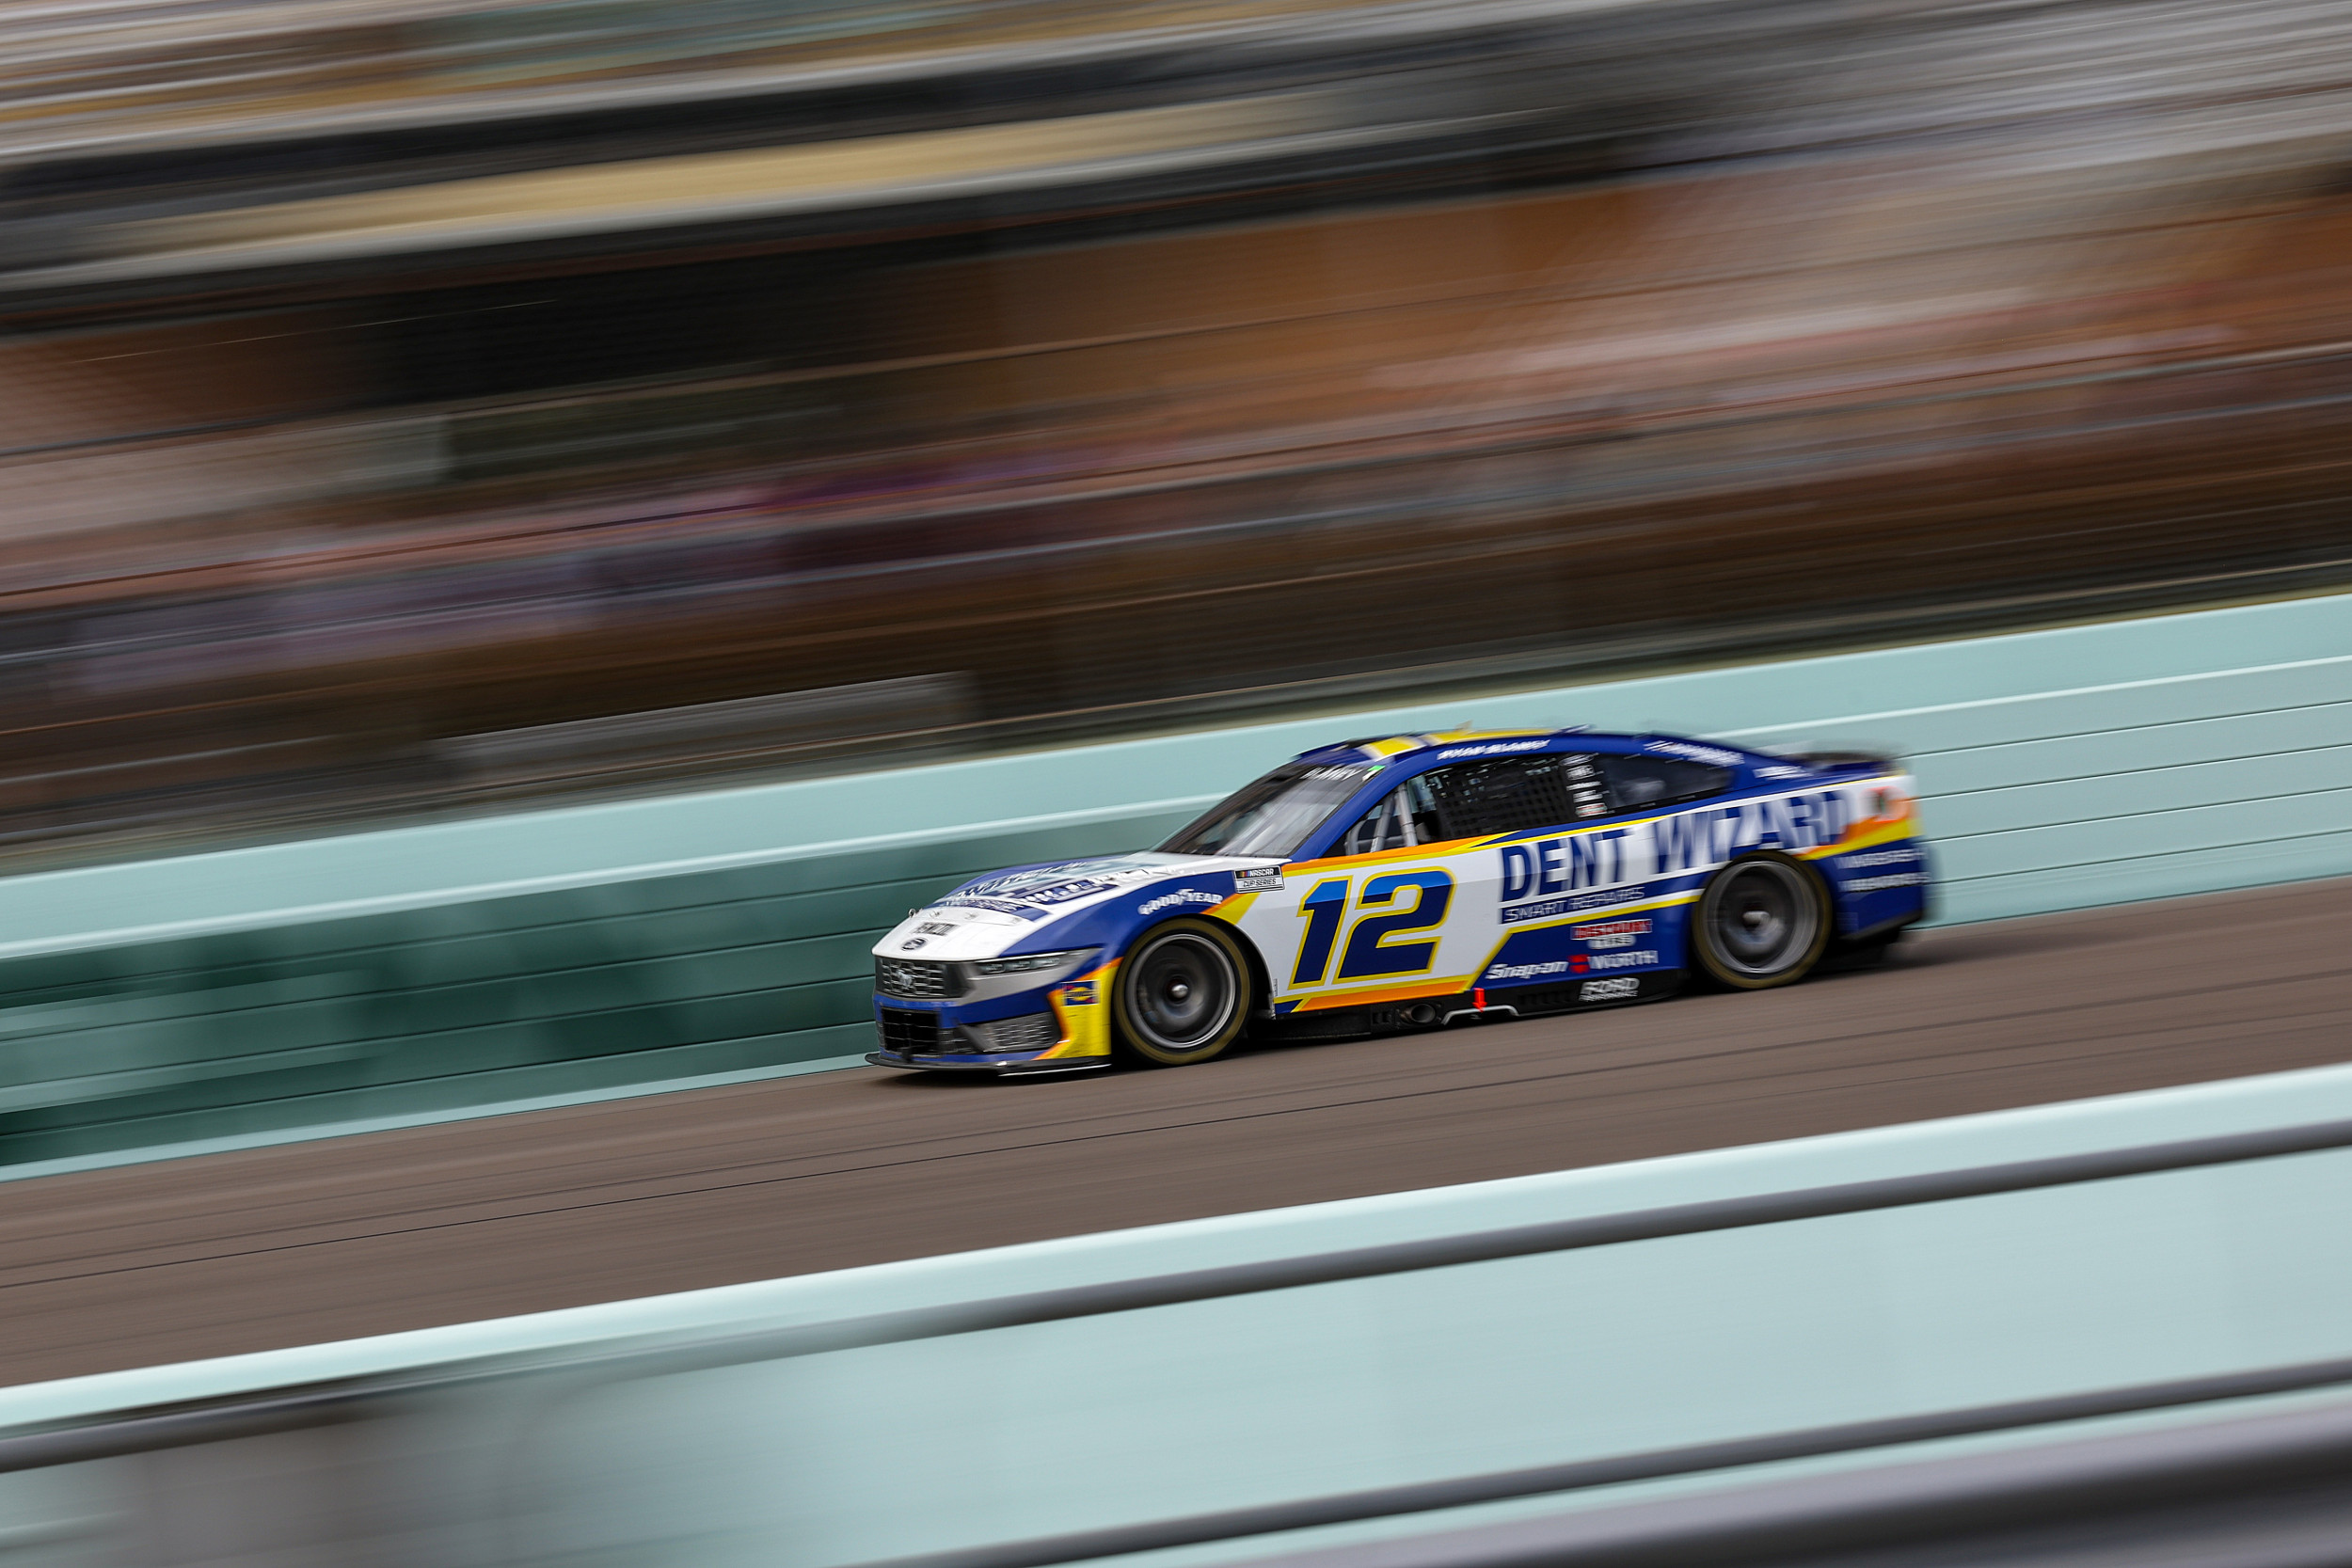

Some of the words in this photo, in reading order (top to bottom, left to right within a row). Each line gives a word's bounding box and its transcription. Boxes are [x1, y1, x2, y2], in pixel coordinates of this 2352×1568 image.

[1500, 829, 1632, 900] DENT
[1654, 790, 1846, 875] WIZARD
[1249, 868, 1275, 878] NASCAR
[1243, 879, 1256, 888] CUP
[1257, 878, 1277, 887] SERIES
[1504, 900, 1566, 922] SMART
[1567, 887, 1645, 911] REPAIRS
[1287, 865, 1457, 990] 12
[1485, 961, 1569, 979] Snap-on
[1581, 977, 1640, 995] FORD
